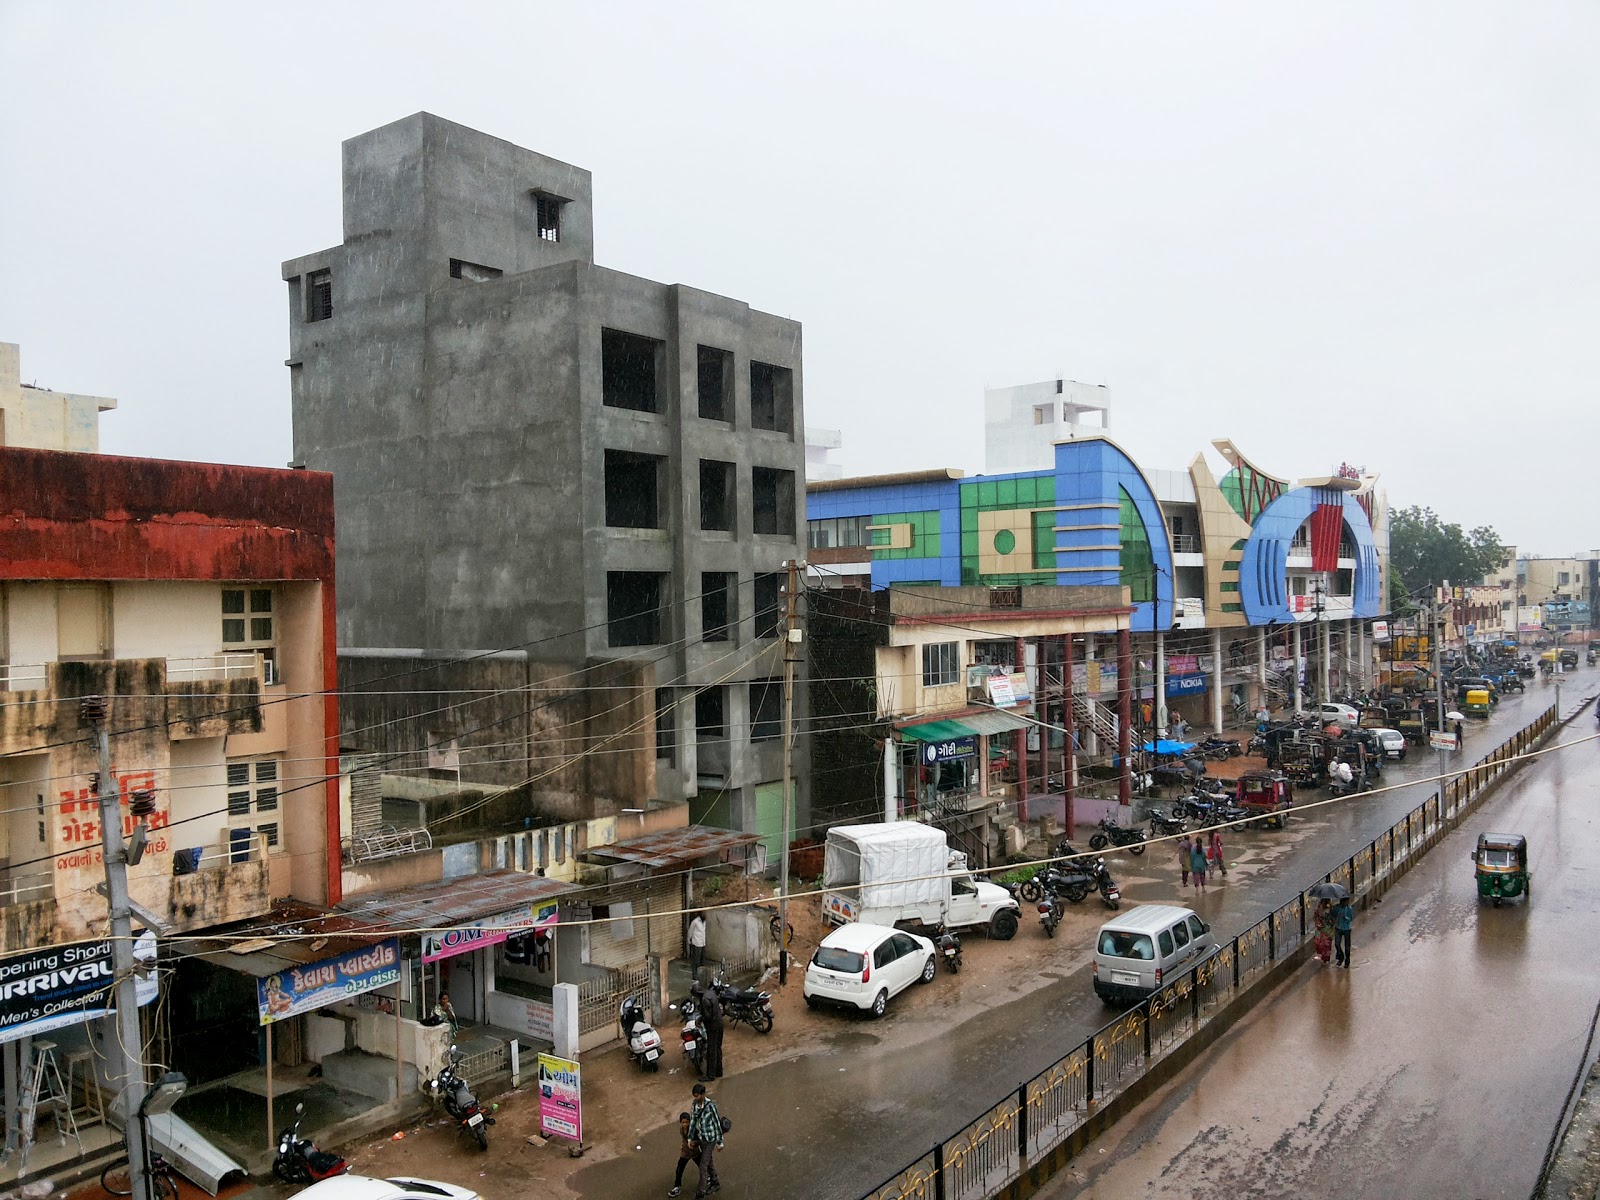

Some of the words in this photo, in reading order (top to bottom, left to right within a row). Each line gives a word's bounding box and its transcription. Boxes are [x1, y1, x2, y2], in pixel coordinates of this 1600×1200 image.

[1180, 678, 1203, 688] NOKIA
[443, 923, 483, 947] OM
[0, 956, 57, 980] pening
[291, 969, 336, 993] કૈલાશ
[0, 1007, 39, 1026] Men's
[43, 992, 104, 1014] Collection
